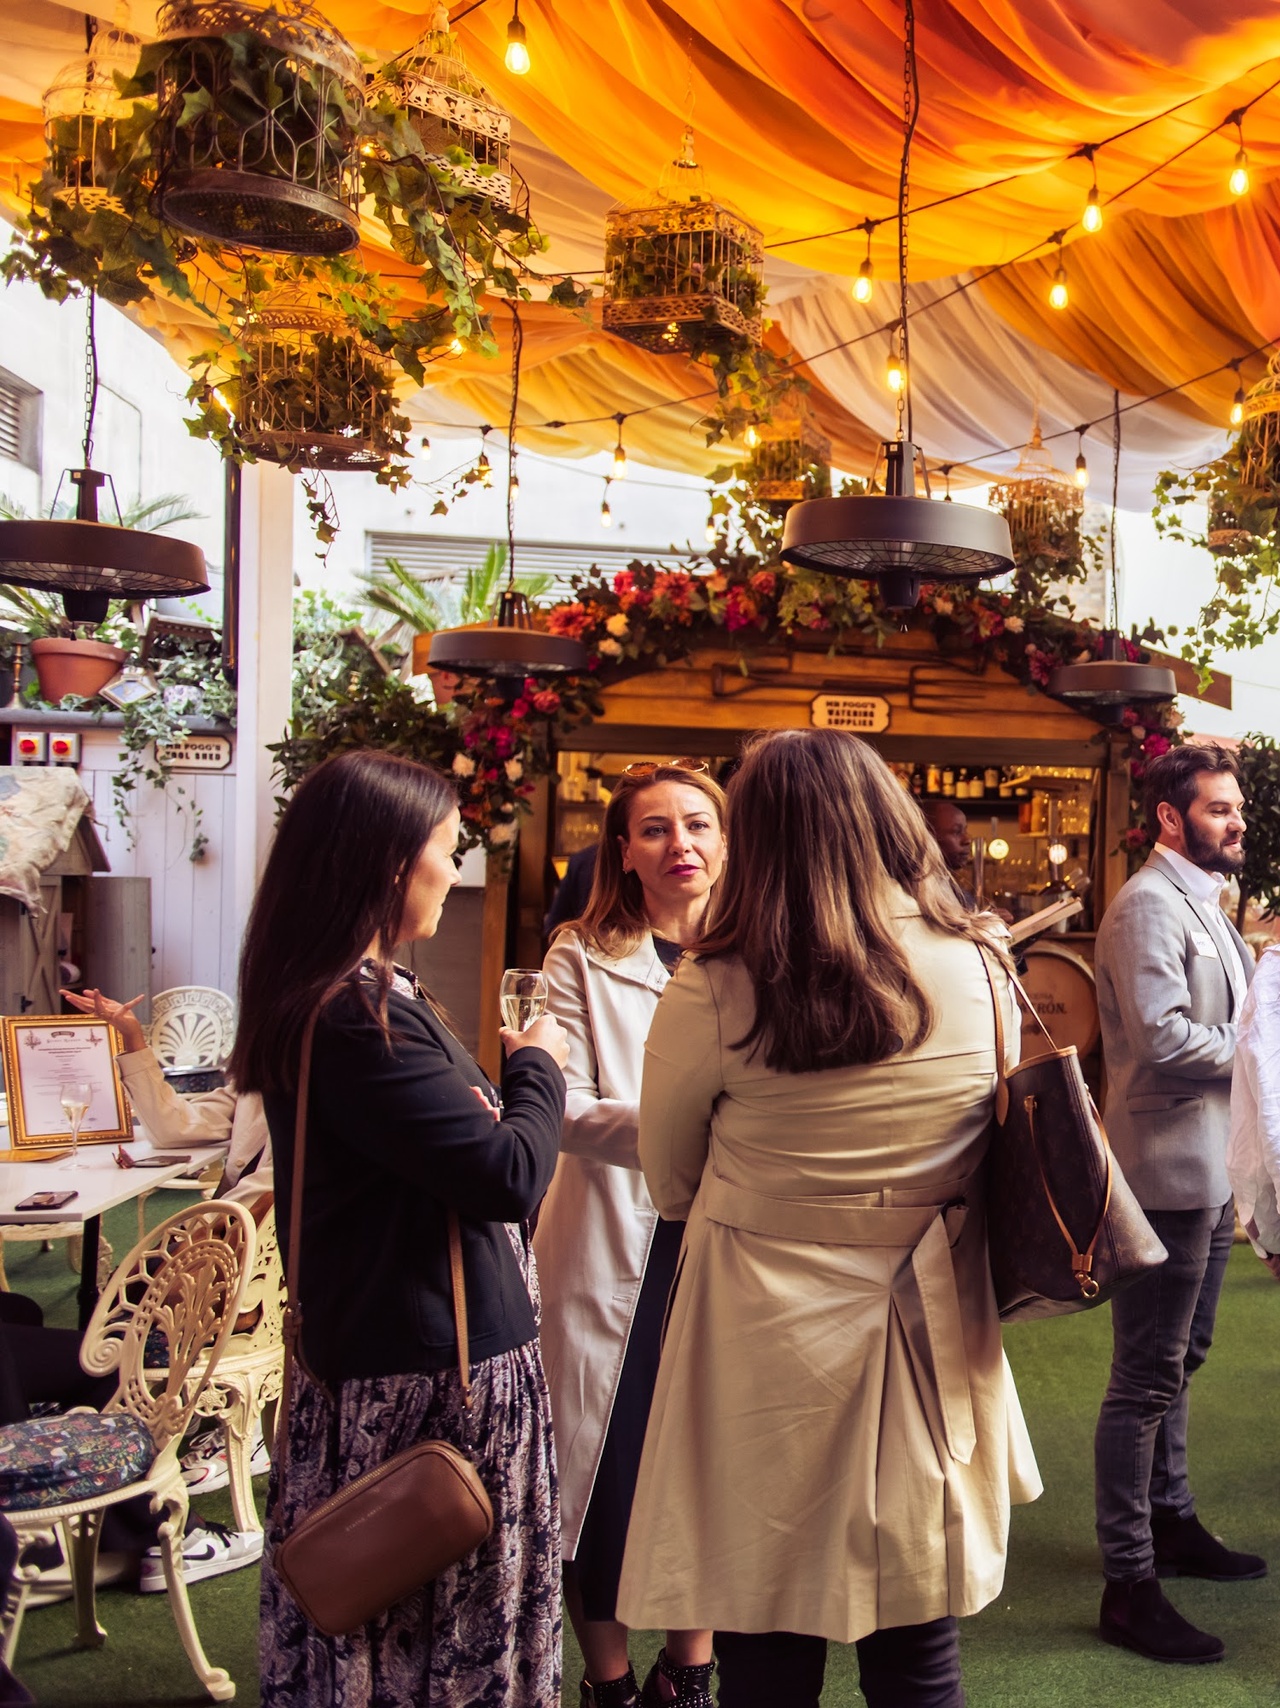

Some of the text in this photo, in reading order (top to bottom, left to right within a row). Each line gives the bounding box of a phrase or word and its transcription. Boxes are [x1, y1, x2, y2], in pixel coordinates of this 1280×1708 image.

[843, 701, 876, 709] FOGG'S
[828, 710, 874, 718] WATERING
[828, 718, 874, 726] SUPPLIES
[194, 752, 221, 760] SHED
